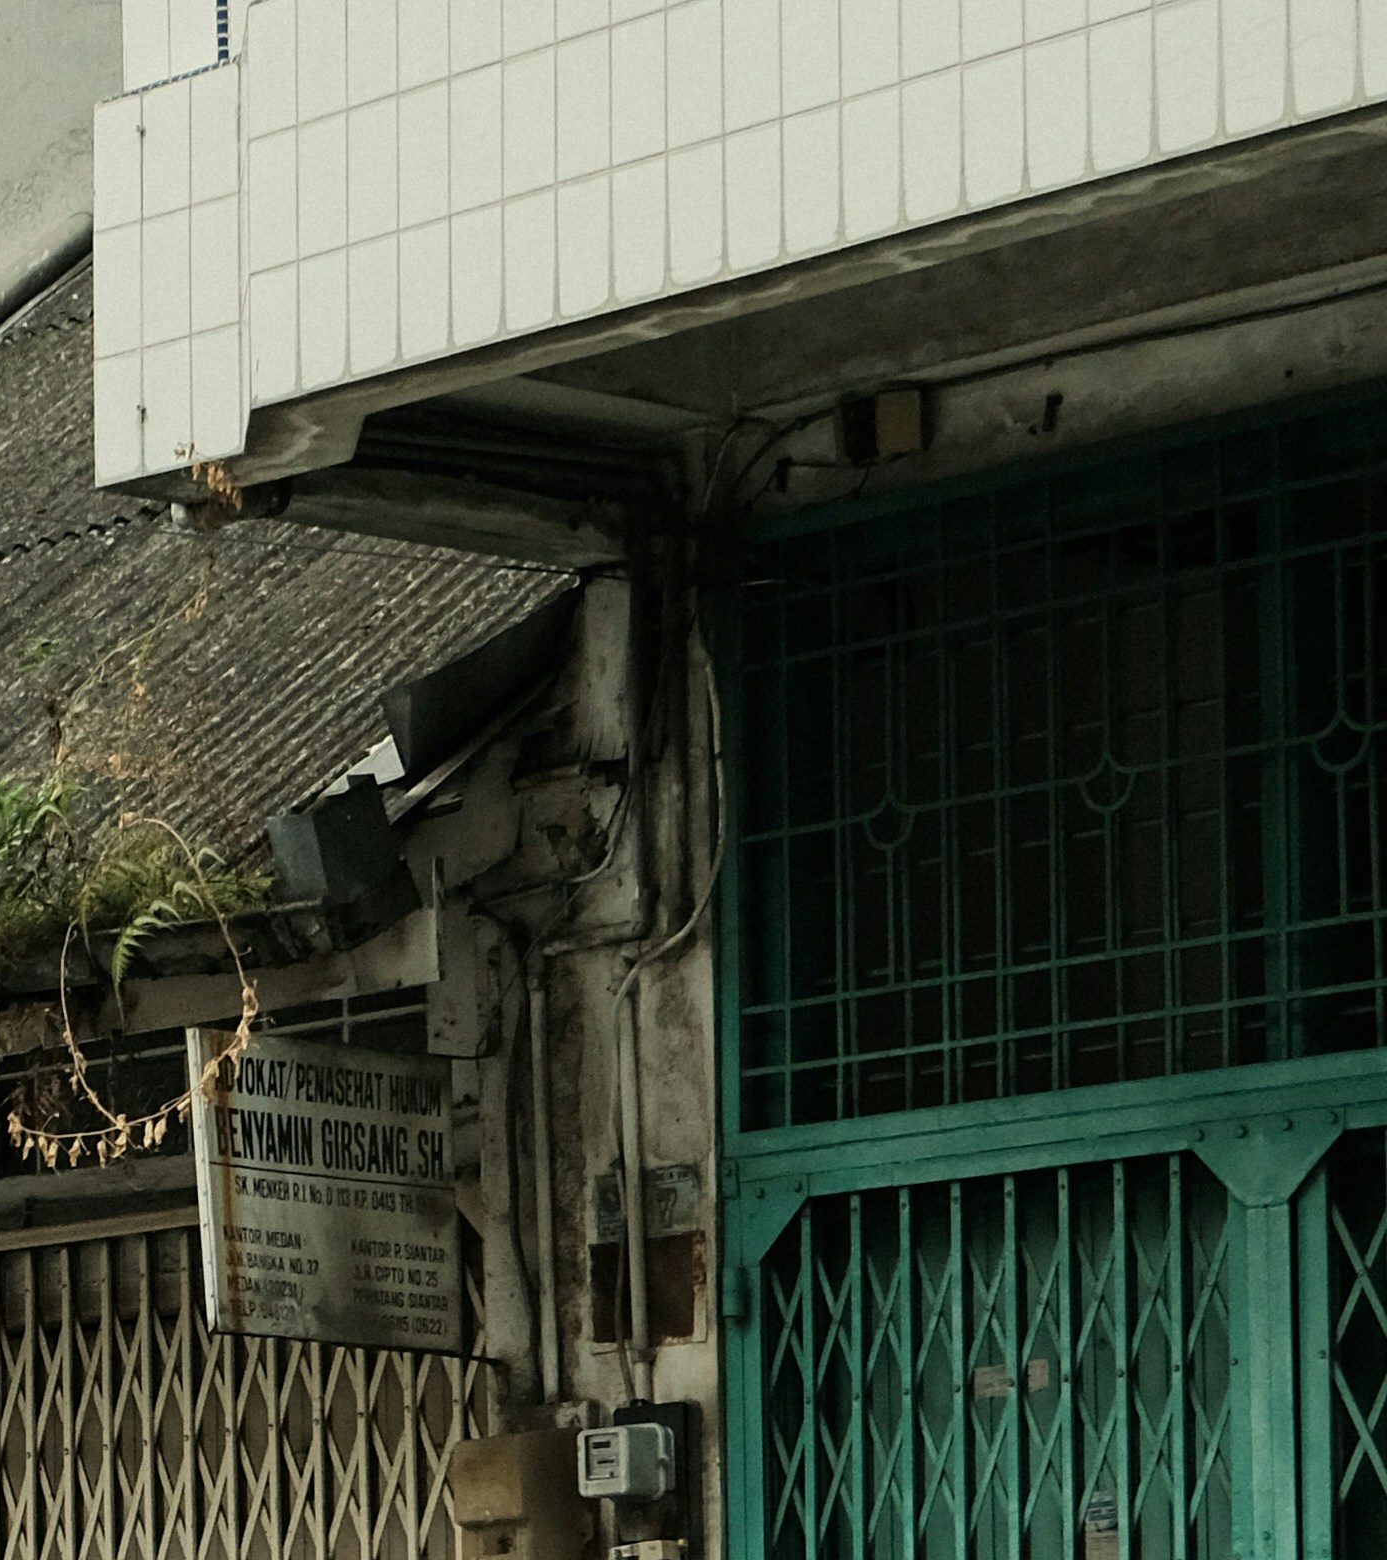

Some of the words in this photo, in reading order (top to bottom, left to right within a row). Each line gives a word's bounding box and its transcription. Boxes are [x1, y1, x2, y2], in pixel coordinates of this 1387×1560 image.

[389, 1073, 442, 1117] HUKUM
[215, 1105, 314, 1167] BENYAMIN
[222, 1225, 262, 1245] KANTOR
[350, 1238, 391, 1258] KANTOR
[307, 1258, 320, 1276] 37
[374, 1265, 405, 1284] CIPTO
[227, 1274, 261, 1293] MEDAN
[408, 1292, 449, 1312] SIANTAR
[411, 1315, 448, 1337] (0622)
